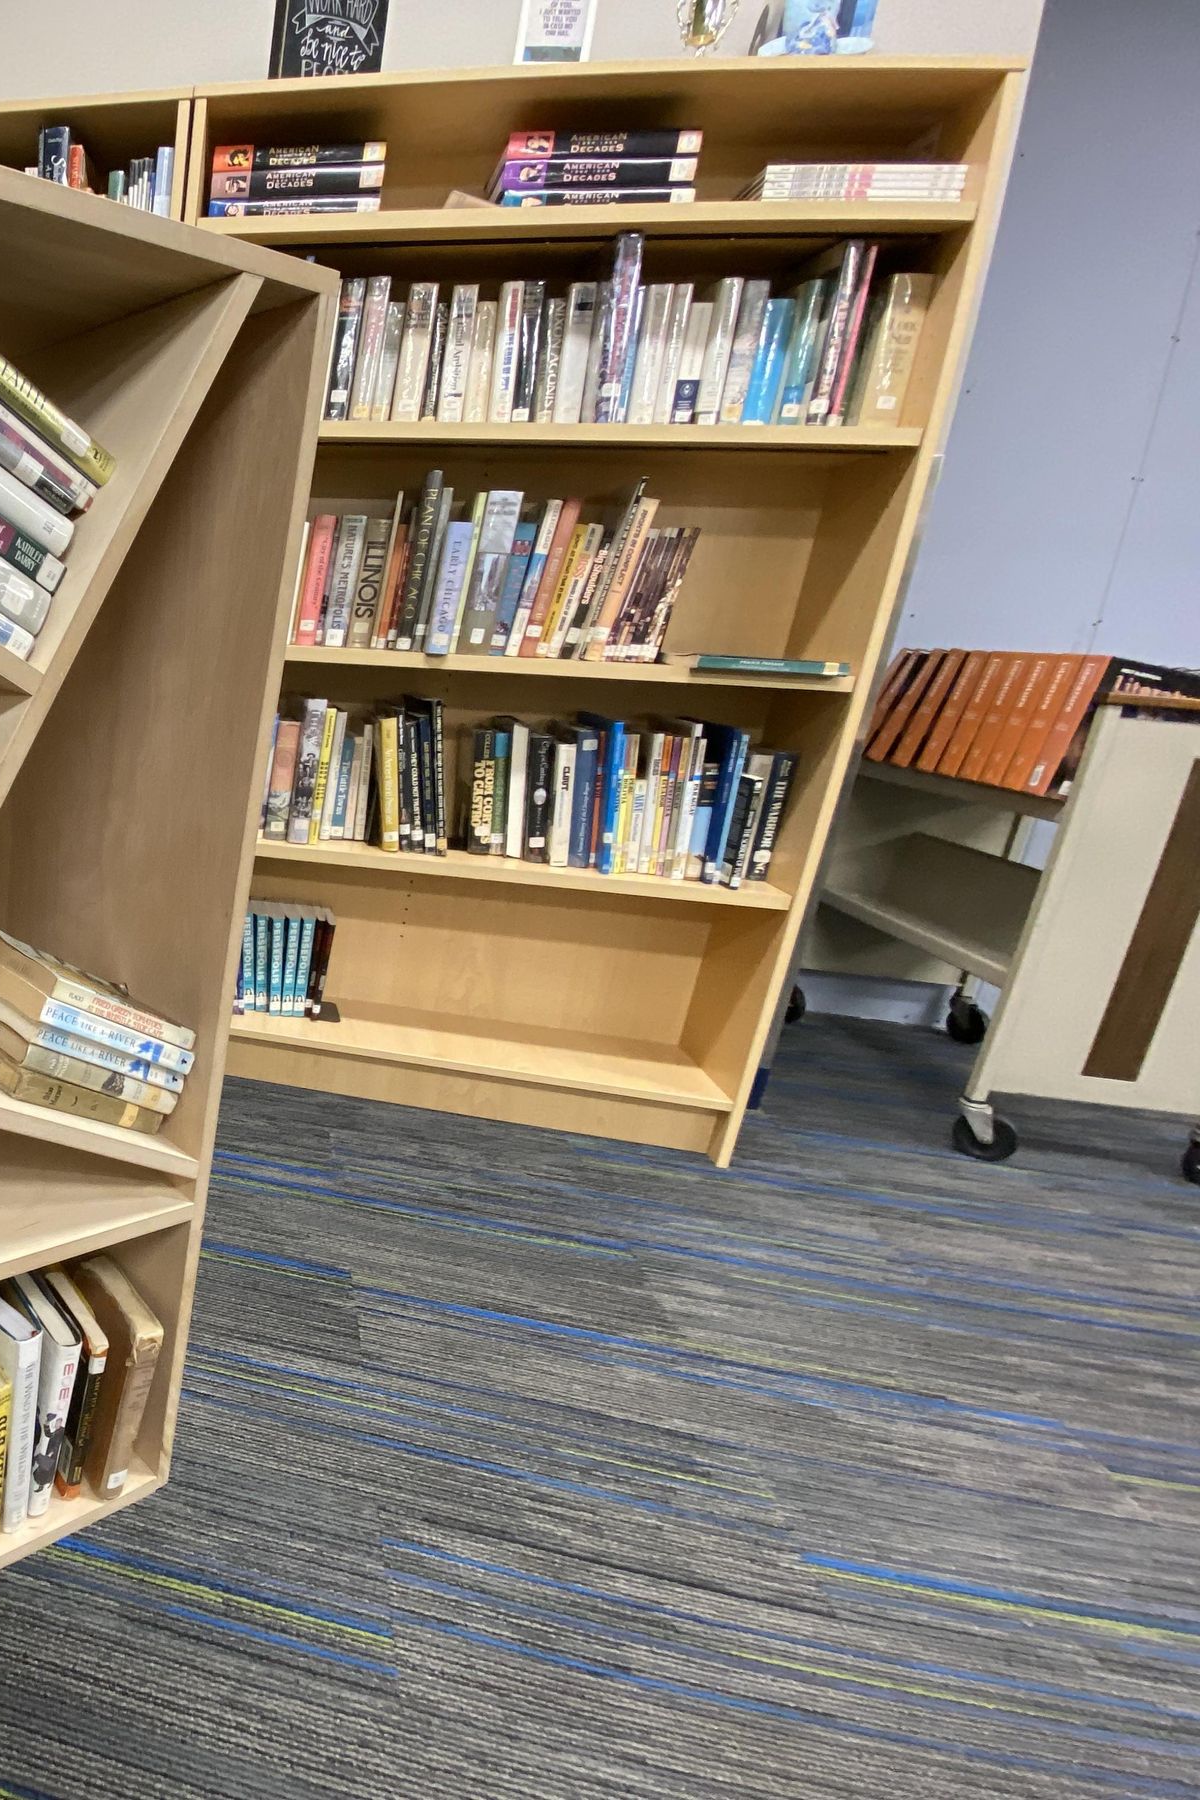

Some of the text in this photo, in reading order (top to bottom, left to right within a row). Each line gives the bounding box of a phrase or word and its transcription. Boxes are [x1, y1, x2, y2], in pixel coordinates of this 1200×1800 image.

[316, 23, 353, 39] and
[321, 41, 350, 68] nice
[350, 45, 366, 71] to
[269, 145, 320, 155] AMERICAN
[571, 132, 628, 141] AMERICAN
[571, 143, 625, 153] DECADES
[266, 170, 317, 180] AMERICAN
[269, 155, 317, 166] DECADES
[563, 161, 620, 171] AMERICAN
[563, 172, 616, 182] DECADES
[266, 179, 314, 189] DECADES
[563, 191, 620, 200] AMERICAN
[0, 358, 48, 412] FAITH
[14, 536, 45, 564] KATHLEE
[405, 488, 439, 619] PLAN OF CHICAGO
[617, 541, 635, 586] CONFLICT
[332, 525, 355, 630] NATURE'S METROPOLIS
[355, 540, 386, 619] ILLINOIS
[438, 540, 462, 633] EARLY CHICAGO
[582, 548, 609, 605] Big Shoulders
[411, 767, 419, 785] COULD
[484, 759, 496, 791] FROM
[561, 766, 571, 792] CLOUT
[471, 762, 485, 828] TO CASTRO
[761, 780, 789, 849] THE WARRIOR
[243, 916, 252, 978] PERSEPOLIS
[256, 919, 266, 981] PERSEPOLIS
[271, 921, 281, 984] PERSEPOLIS
[285, 922, 298, 984] PERSEPOLIS
[298, 923, 313, 985] PERSEPOLIS
[45, 1006, 138, 1048] PEACE LIKE RIVER
[36, 1028, 70, 1048] PEACE
[70, 1041, 88, 1055] LIKE
[98, 1050, 127, 1067] RIVER
[22, 1383, 35, 1412] WIND
